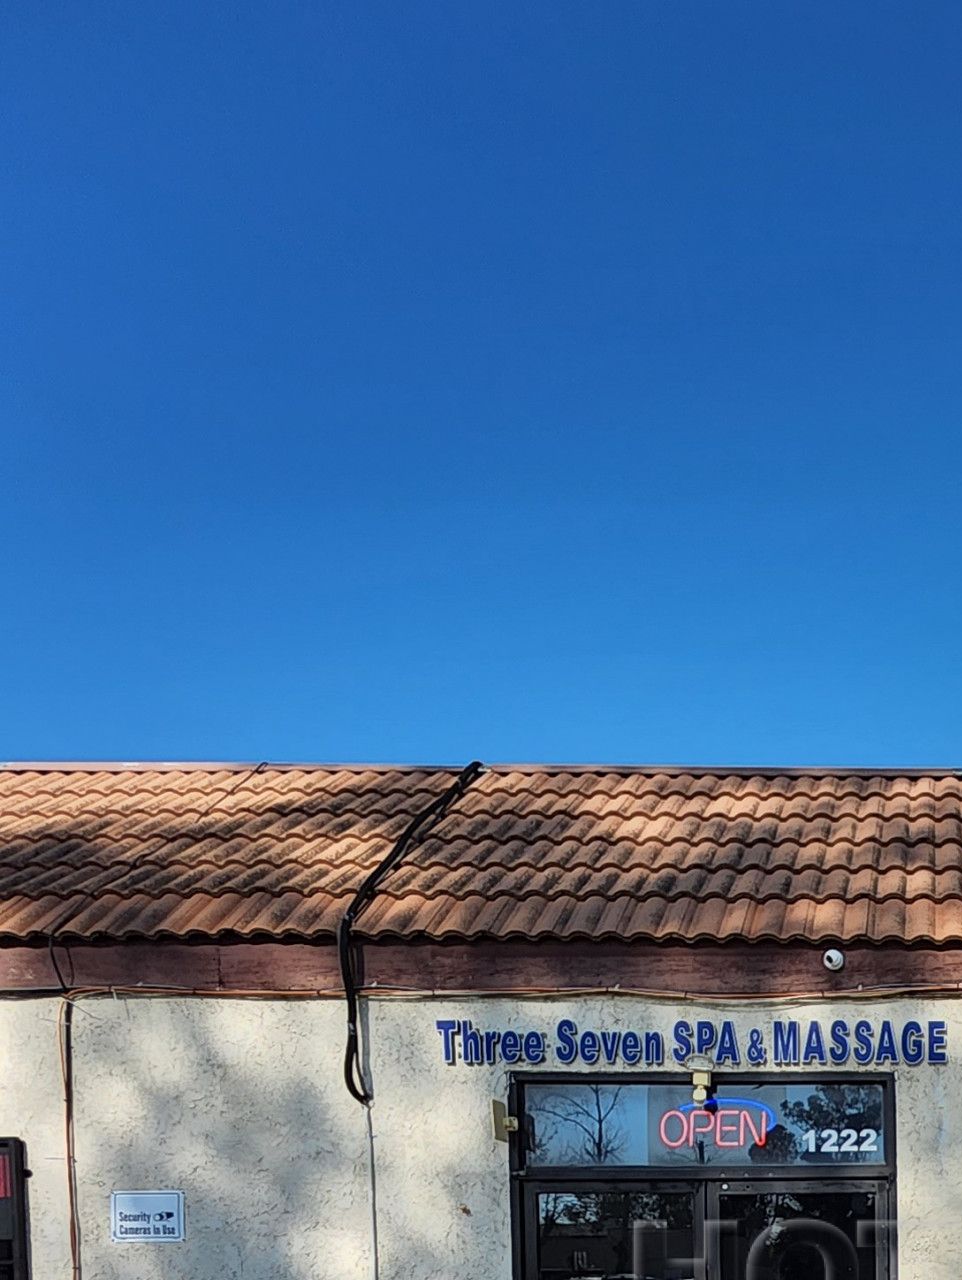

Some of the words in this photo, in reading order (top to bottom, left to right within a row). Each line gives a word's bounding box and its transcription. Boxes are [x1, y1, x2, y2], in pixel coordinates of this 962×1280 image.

[436, 1020, 546, 1064] Three
[556, 1019, 663, 1065] Seven
[672, 1019, 739, 1064] SPA
[747, 1027, 767, 1064] &
[773, 1019, 949, 1065] MASSAGE
[659, 1110, 768, 1149] OPEN
[802, 1128, 879, 1153] 1222
[119, 1211, 151, 1224] Security
[119, 1225, 151, 1235] Cameras
